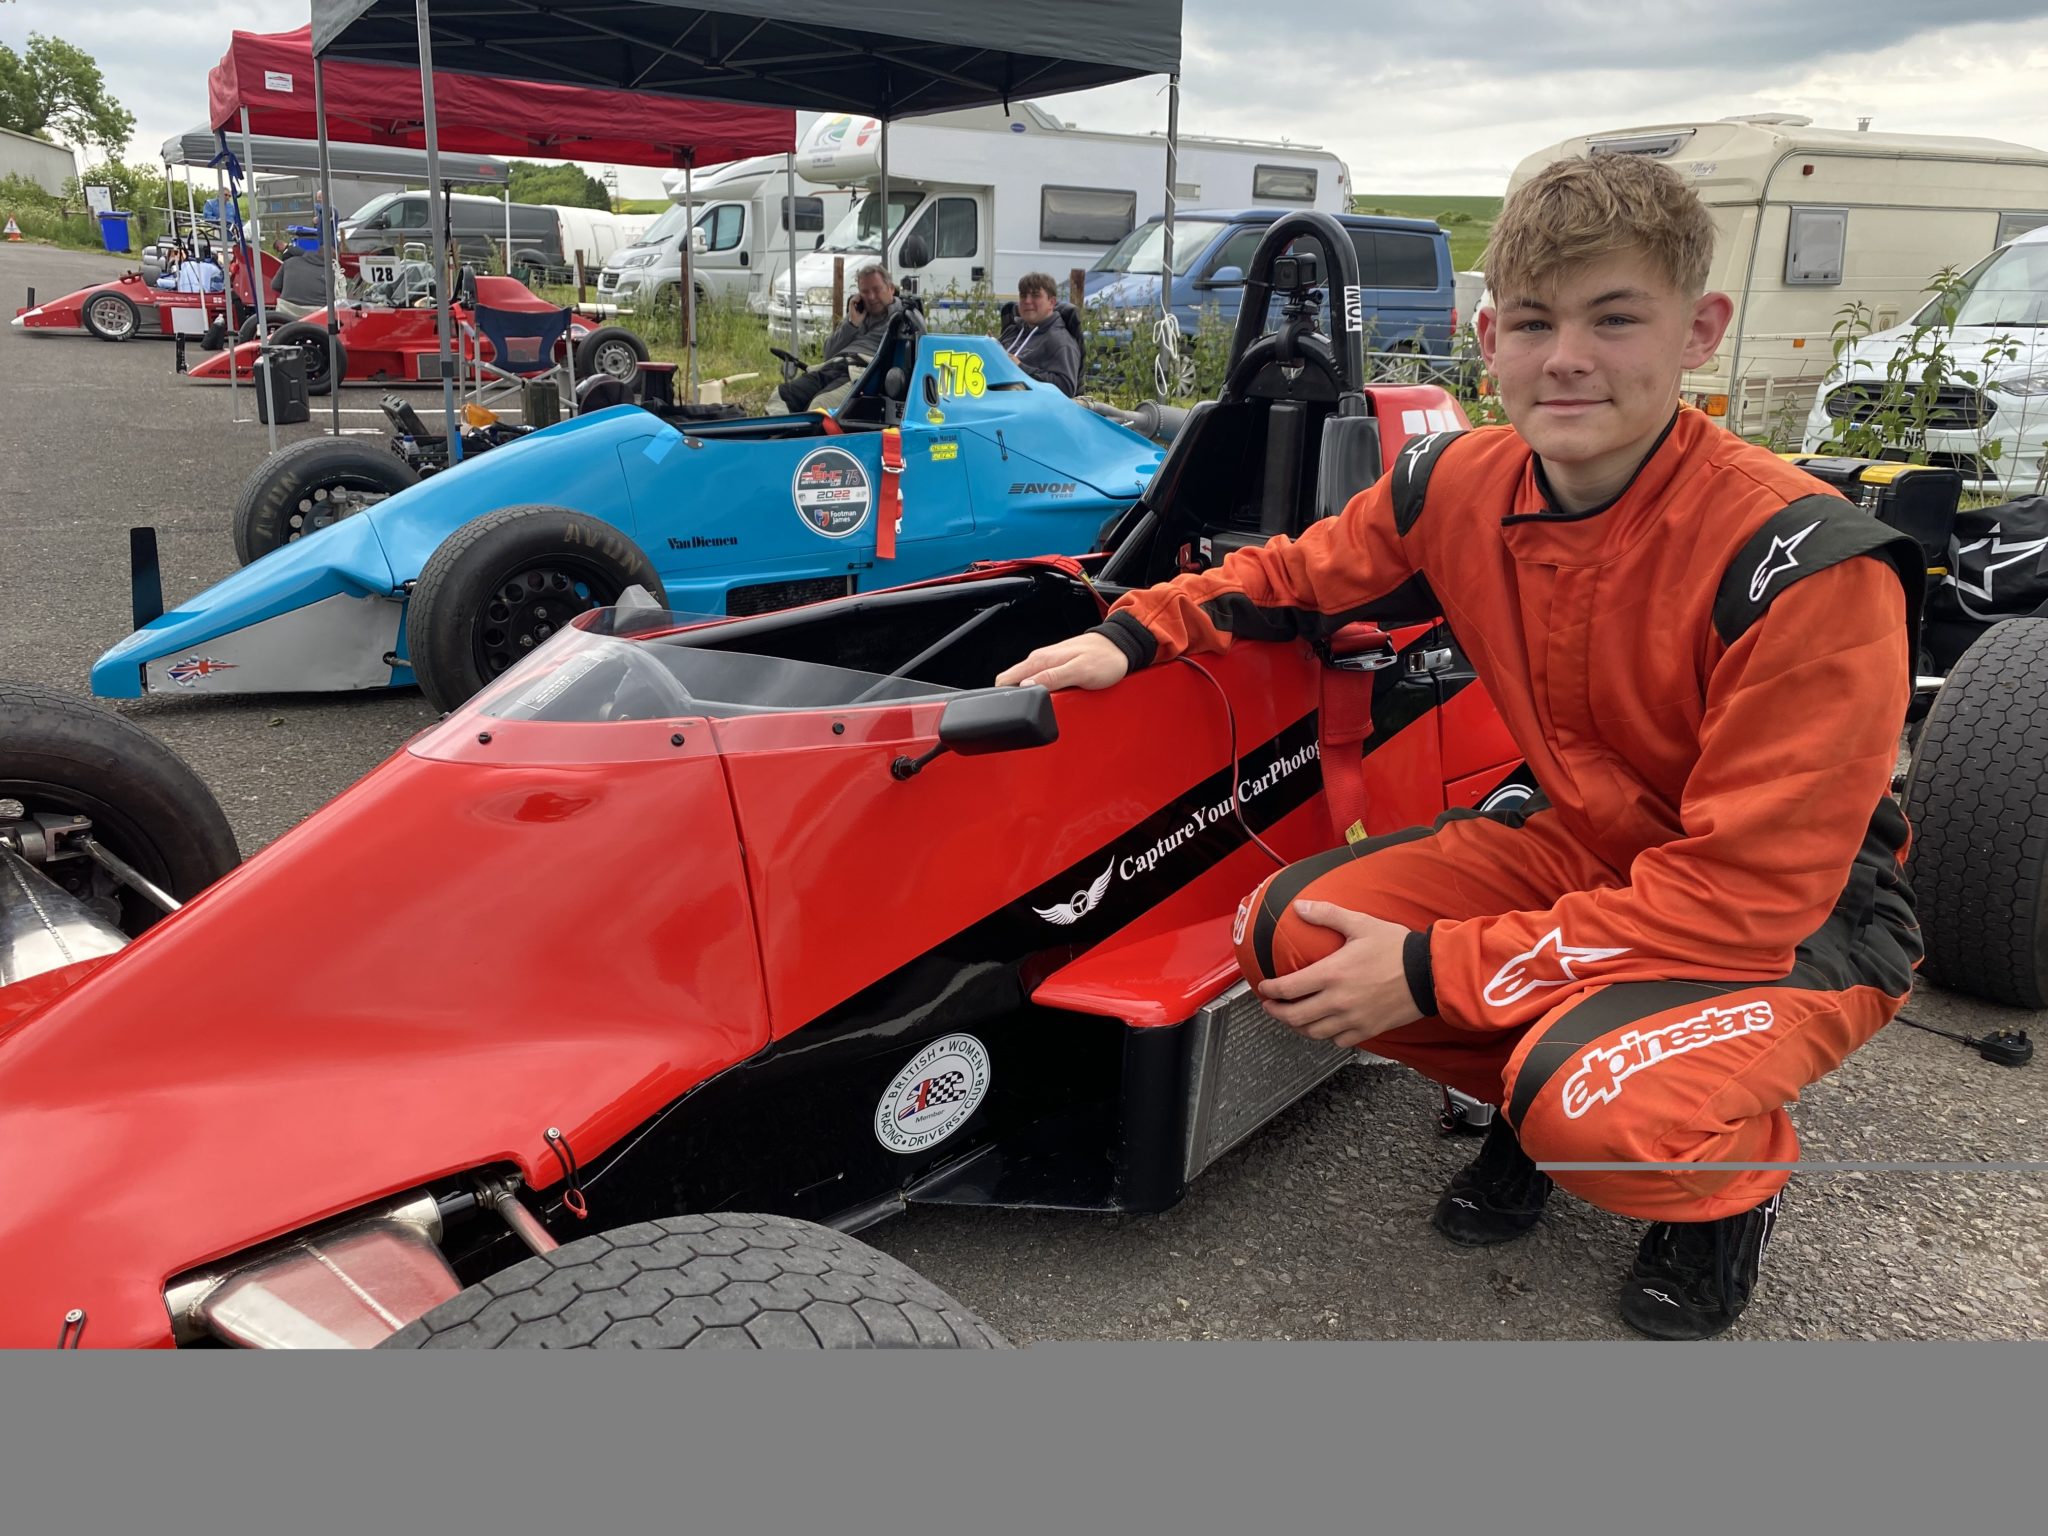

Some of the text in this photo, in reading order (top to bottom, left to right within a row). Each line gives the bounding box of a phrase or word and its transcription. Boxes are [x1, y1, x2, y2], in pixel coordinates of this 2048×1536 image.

[371, 267, 394, 282] 128
[1346, 288, 1361, 330] TOW
[934, 350, 986, 397] 776
[816, 489, 850, 499] 2022
[1024, 482, 1076, 494] AVON
[564, 523, 642, 576] AVON
[888, 1040, 985, 1099] BRITISH WOMEN
[881, 1078, 985, 1147] RACING DRIVERS CLUB
[915, 1109, 945, 1123] Member
